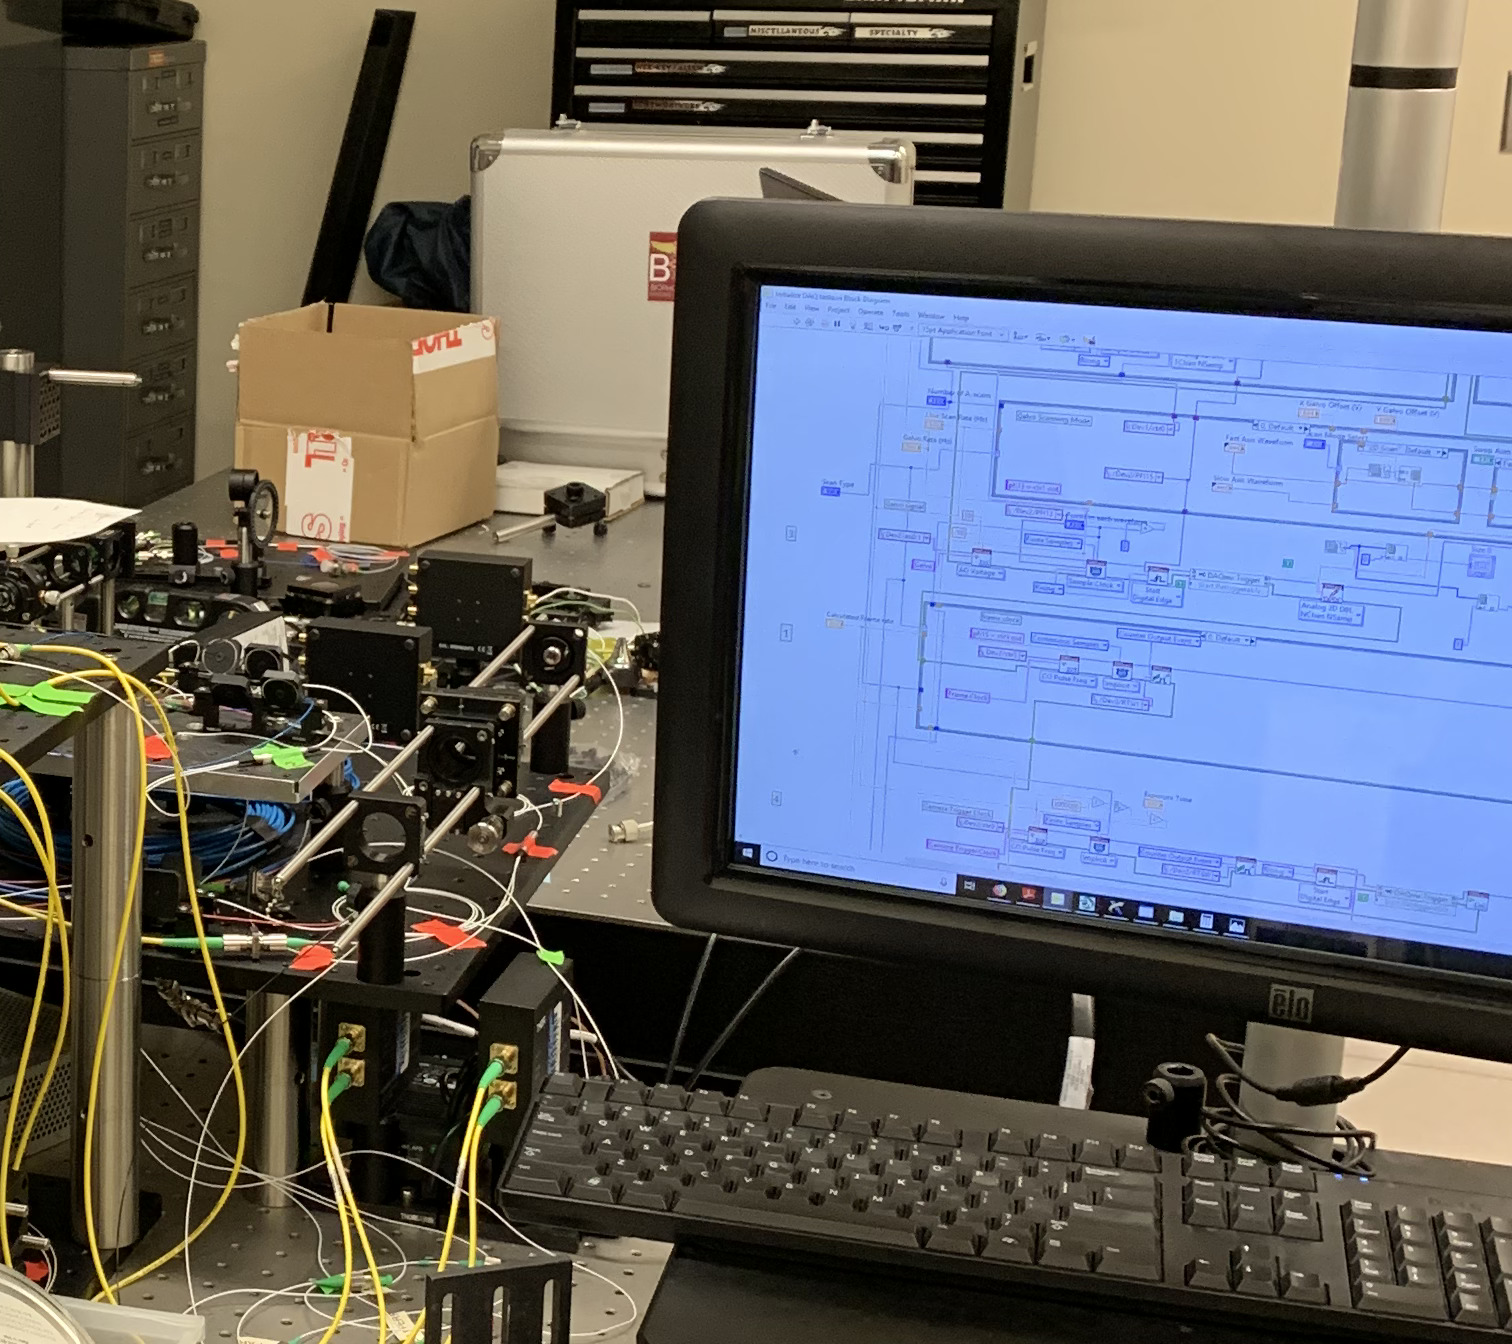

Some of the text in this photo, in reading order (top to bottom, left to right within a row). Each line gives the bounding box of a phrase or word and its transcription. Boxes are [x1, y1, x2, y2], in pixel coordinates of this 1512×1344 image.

[750, 26, 821, 36] MISCELLANEOUS
[869, 28, 919, 37] SPECIALTY
[804, 305, 820, 313] View
[827, 305, 850, 315] Project
[858, 308, 884, 317] Operate
[892, 310, 910, 318] Tools
[918, 311, 945, 320] Window
[937, 327, 993, 338] Application Font
[839, 479, 855, 489] Type
[973, 568, 997, 578] Voltage
[1094, 581, 1113, 589] Clock
[783, 855, 799, 866] Type
[801, 857, 820, 866] here
[831, 862, 856, 873] search
